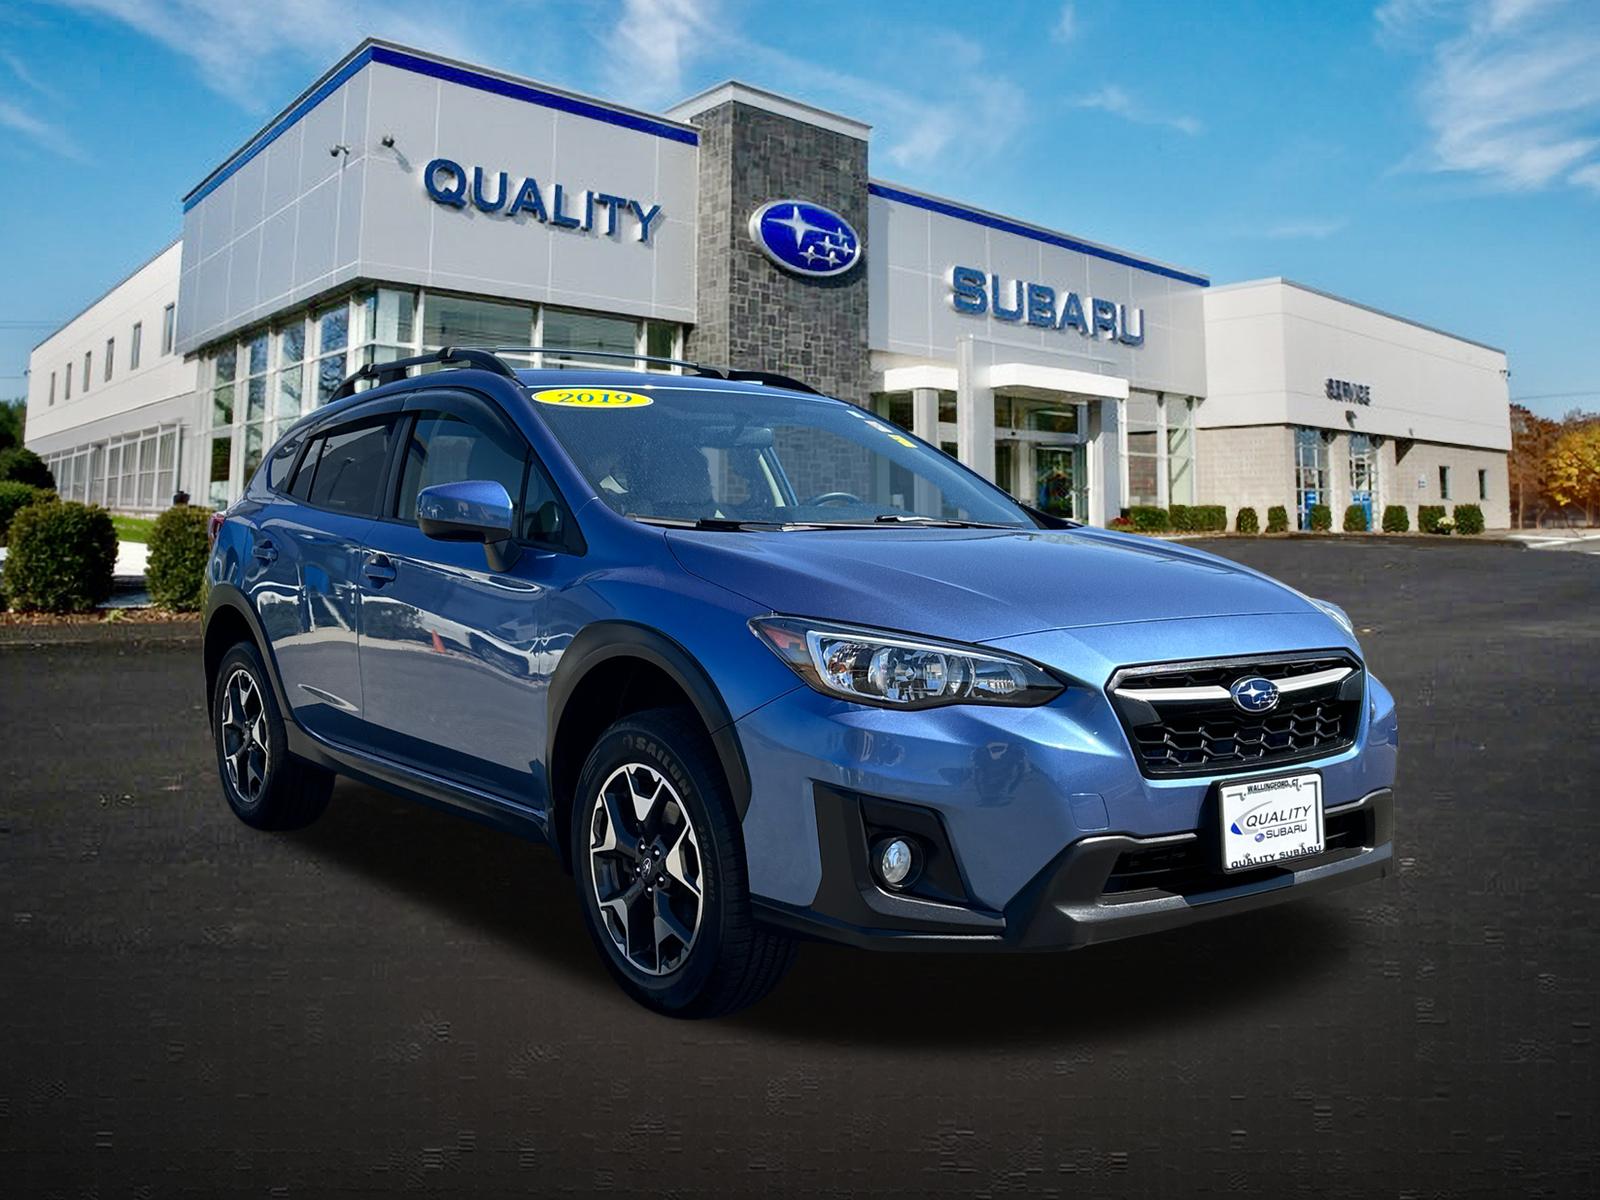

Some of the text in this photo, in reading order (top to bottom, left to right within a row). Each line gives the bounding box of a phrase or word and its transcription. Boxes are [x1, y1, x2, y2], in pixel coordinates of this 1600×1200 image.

[423, 158, 662, 243] QUALITY
[950, 265, 1145, 347] SUBARU
[557, 392, 632, 404] 2019
[1325, 378, 1371, 407] SERVICE
[635, 736, 692, 797] SAILUN
[1246, 804, 1312, 828] QUALITY
[1266, 823, 1308, 839] SUBARU
[1231, 844, 1322, 869] QUALITY SUBARU
